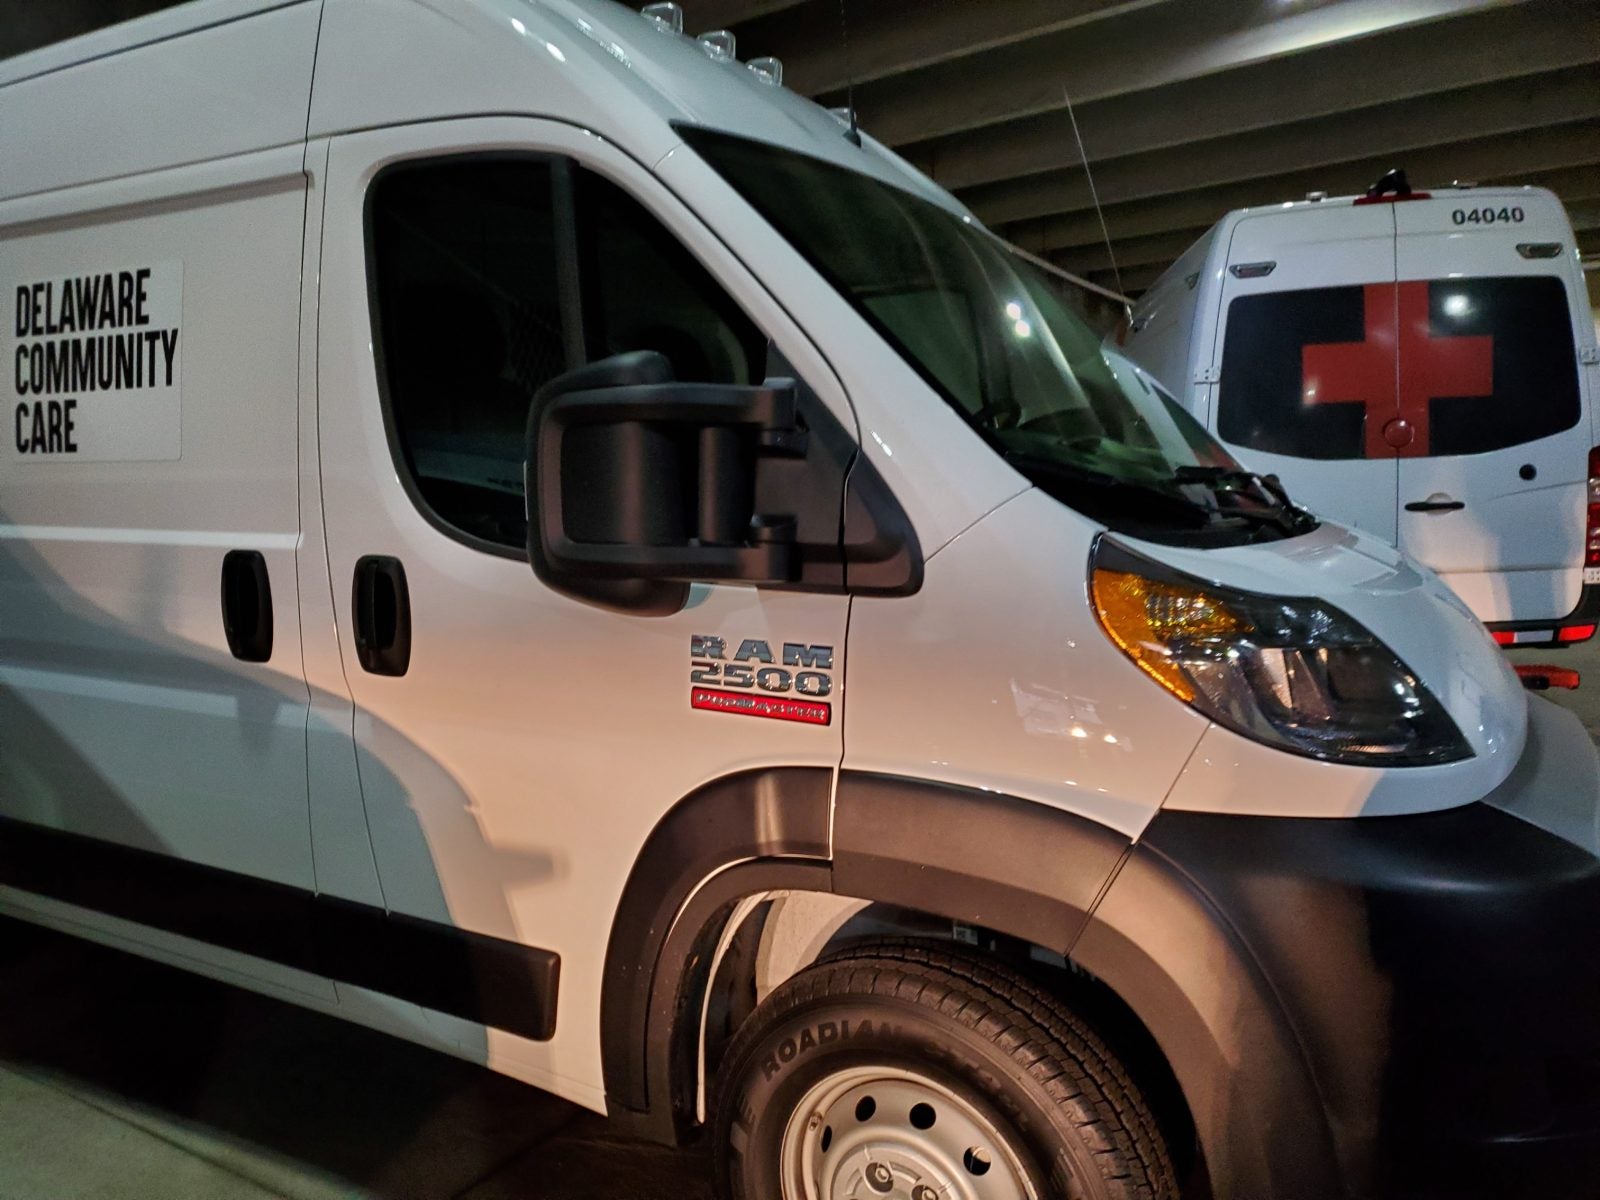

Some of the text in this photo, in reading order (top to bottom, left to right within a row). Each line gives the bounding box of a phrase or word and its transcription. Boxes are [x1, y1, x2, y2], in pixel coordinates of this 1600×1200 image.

[1452, 207, 1525, 225] 04040
[15, 268, 151, 337] DELAWARE
[15, 328, 178, 395] COMMUNITY
[15, 399, 77, 453] CARE
[691, 635, 833, 669] RAM
[691, 661, 832, 697] 2500
